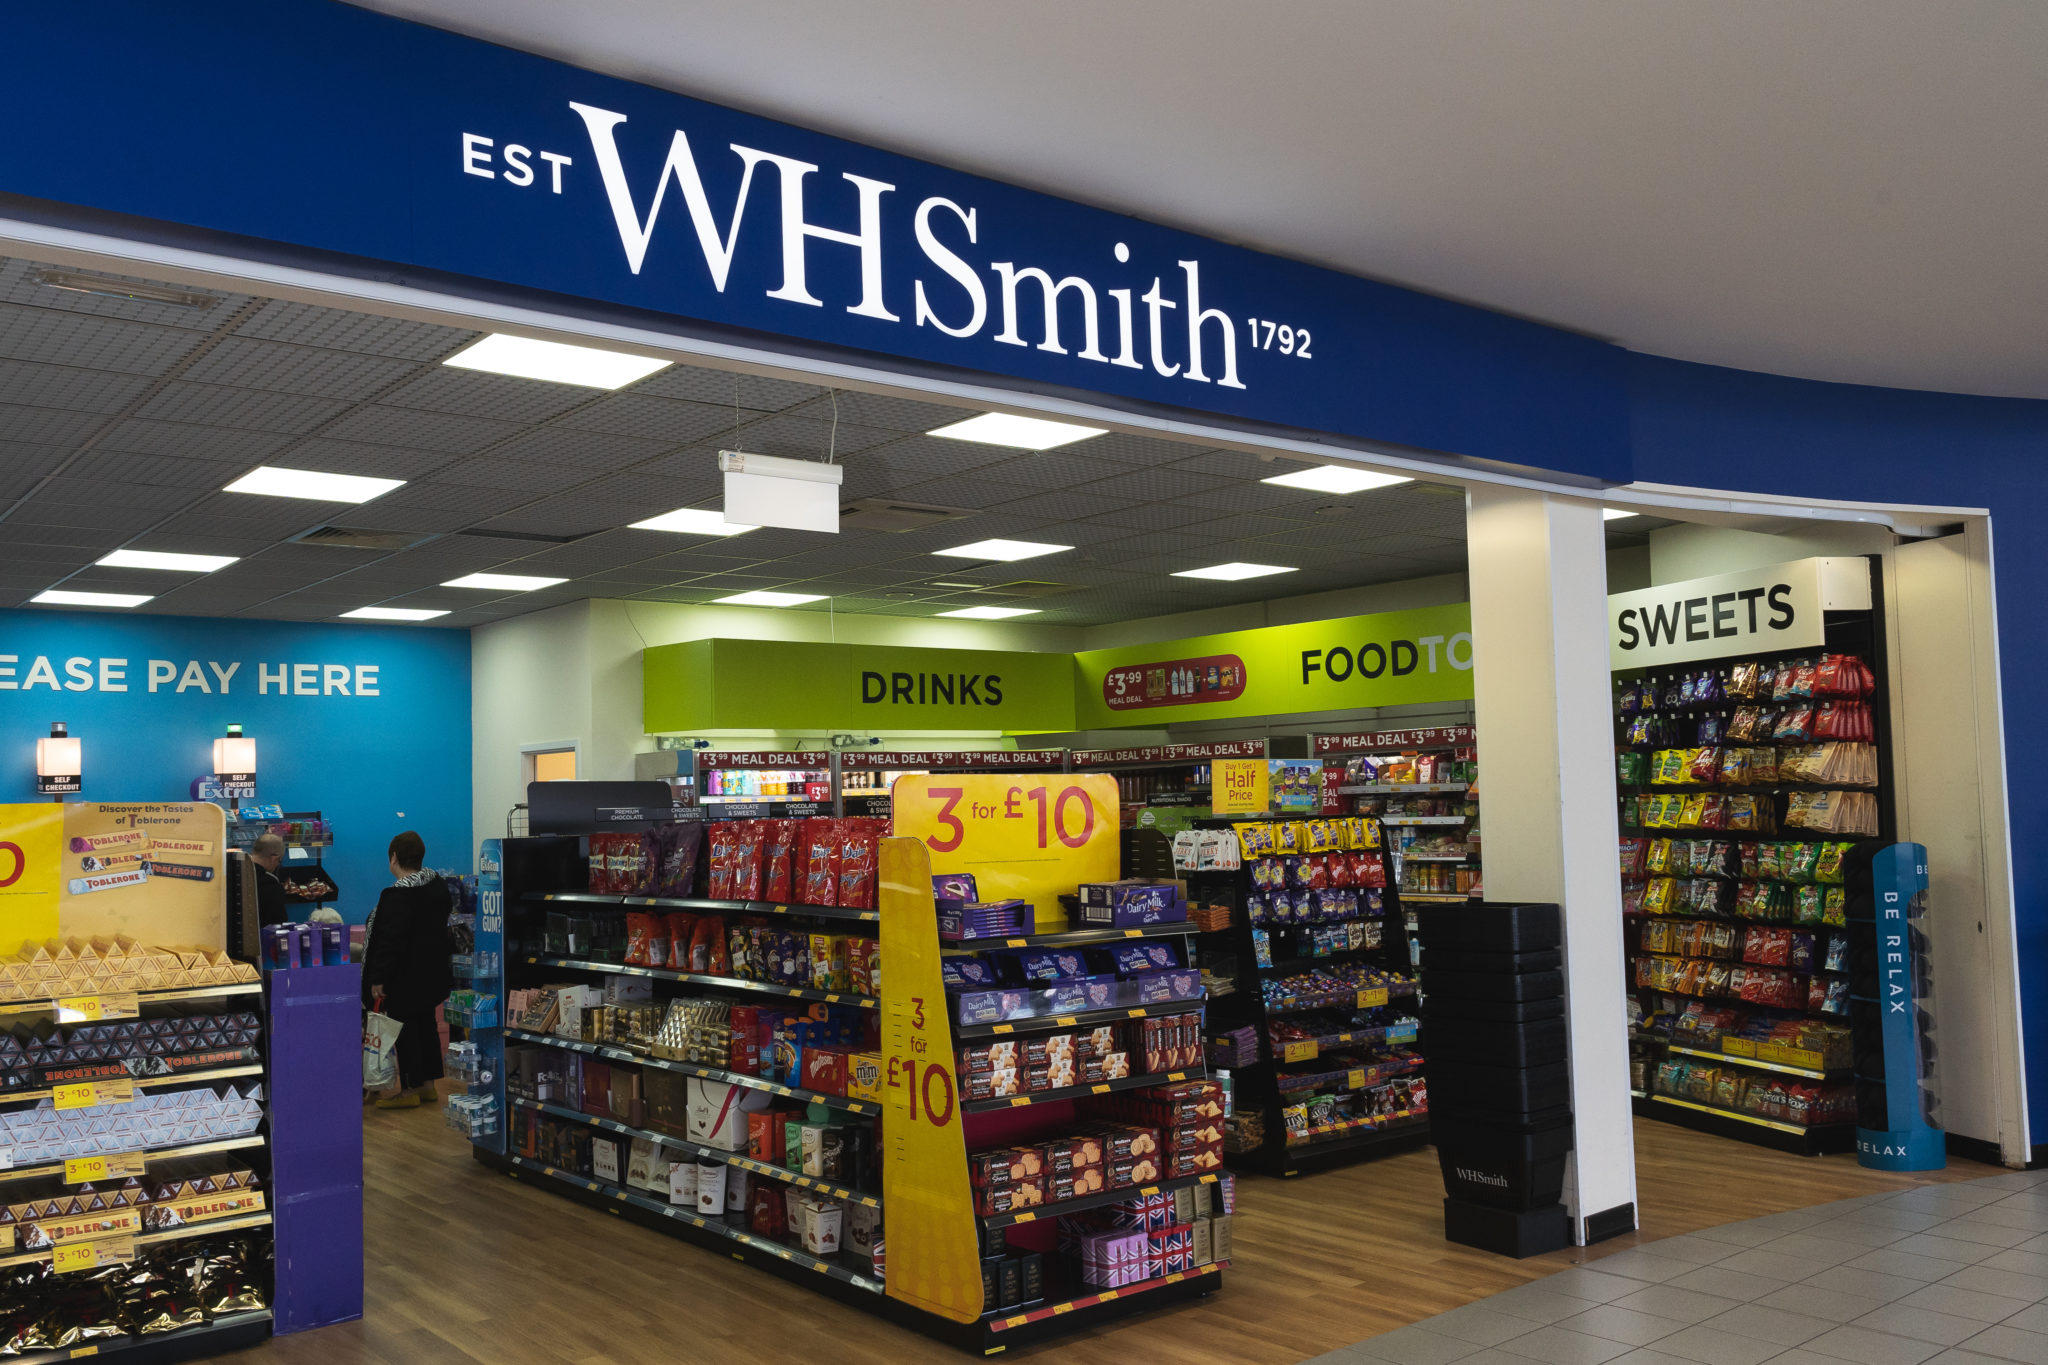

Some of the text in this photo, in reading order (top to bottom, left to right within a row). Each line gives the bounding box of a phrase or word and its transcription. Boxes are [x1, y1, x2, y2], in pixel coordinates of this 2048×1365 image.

[462, 100, 1312, 390] EST WHSmith 1792
[1618, 583, 1795, 650] SWEETS
[148, 658, 241, 695] PAY
[259, 662, 380, 697] HERE
[862, 671, 1003, 706] DRINKS
[1108, 696, 1125, 705] MEAL
[1126, 695, 1142, 704] DEAL
[1318, 736, 1340, 750] £3.99
[1342, 735, 1374, 748] MEAL
[1377, 733, 1408, 746] DEAL
[1411, 730, 1435, 744] £3.99
[1091, 753, 1115, 762] MEAL
[1116, 751, 1139, 761] DEAL
[1186, 746, 1212, 757] MEAL
[1214, 744, 1240, 755] DEAL
[703, 753, 826, 767] £3.99 MEAL DEAL £3.99
[868, 754, 899, 764] MEAL
[901, 754, 930, 764] DEAL
[983, 753, 1010, 764] MEAL
[1013, 753, 1039, 763] DEAL
[54, 776, 71, 784] SELF
[232, 774, 247, 782] SELF
[1225, 770, 1256, 788] Half
[45, 783, 80, 791] CHECKOUT
[198, 782, 256, 799] Extra
[1229, 790, 1253, 801] Price
[99, 805, 194, 814] Discover the Tastes
[115, 814, 181, 828] of Toblerone
[926, 785, 1095, 853] 3 for £10
[88, 832, 142, 847] TOBLERONE
[152, 840, 204, 851] TOBLERONE
[86, 873, 140, 889] TOBLERONE
[482, 890, 501, 915] GOT
[1126, 902, 1147, 913] Dairy
[482, 915, 502, 933] GUM?
[1884, 891, 1905, 1013] BE RELAX
[968, 1001, 983, 1010] Dairy
[165, 1049, 243, 1069] TOBLERONE
[887, 998, 954, 1128] 3 for £10
[57, 1091, 65, 1100] 3
[69, 1164, 77, 1174] 3
[992, 1175, 1009, 1184] Sheep
[1456, 1167, 1508, 1188] WHSmith
[57, 1252, 66, 1263] 3
